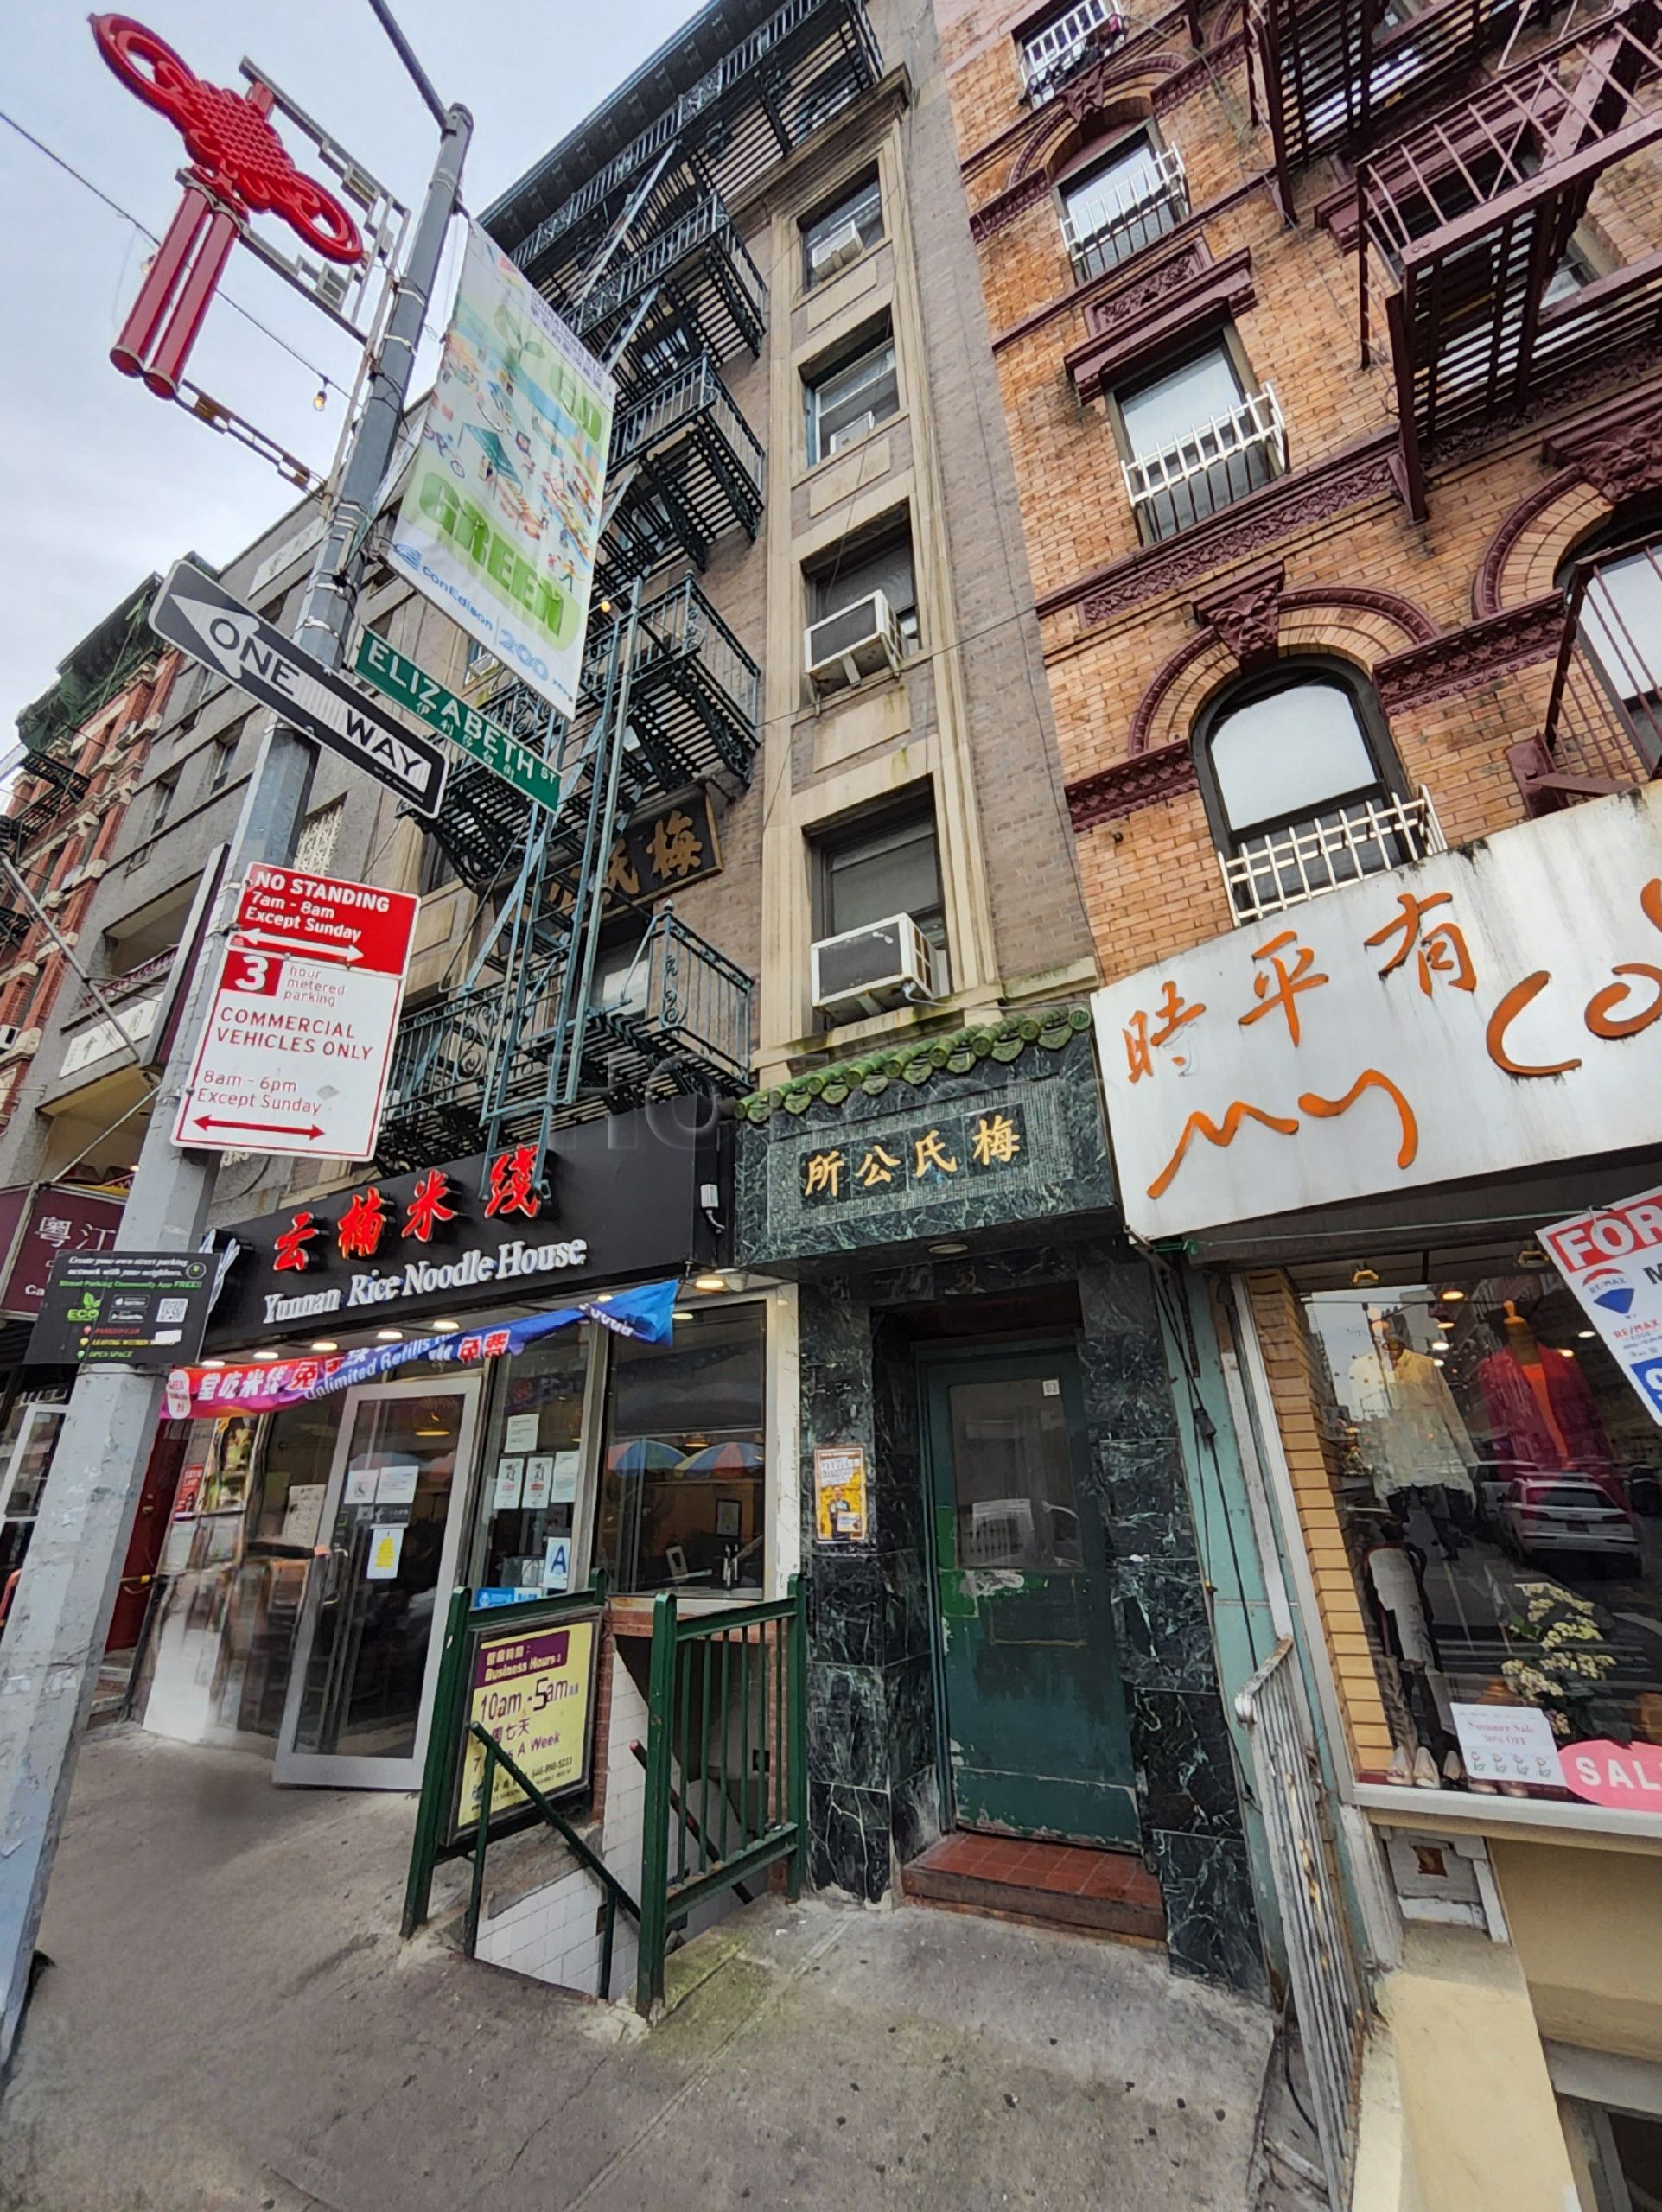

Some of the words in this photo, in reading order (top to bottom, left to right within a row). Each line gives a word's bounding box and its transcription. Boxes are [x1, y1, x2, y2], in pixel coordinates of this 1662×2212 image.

[419, 471, 564, 638] GREEN
[422, 563, 494, 632] conEdison
[498, 627, 551, 683] 200
[209, 616, 301, 696] ONE
[345, 709, 422, 777] WAY
[367, 639, 535, 779] ELIZABETH
[539, 766, 557, 785] ST
[252, 891, 285, 910] 7am
[301, 900, 335, 919] 8am
[255, 872, 286, 891] NO
[290, 878, 391, 912] STANDING
[245, 906, 301, 930] Except
[305, 919, 362, 943] Sunday
[235, 956, 269, 991] 3
[287, 978, 346, 995] metered
[290, 965, 322, 980] hour
[283, 990, 336, 1008] parking
[220, 1007, 355, 1039] COMMERCIAL
[217, 1027, 315, 1053] VEHICLES
[322, 1040, 373, 1061] ONLY
[203, 1069, 242, 1087] 8am
[259, 1076, 297, 1093] 6pm
[197, 1088, 257, 1109] Except
[262, 1094, 322, 1116] Sunday
[805, 1114, 1021, 1197] 梅氏公所
[262, 1287, 342, 1324] Yunnan
[347, 1269, 403, 1307] Rice
[402, 1249, 496, 1296] Noodle
[495, 1238, 589, 1280] House
[1589, 1278, 1627, 1294] RE/MAX
[67, 1308, 100, 1321] ECO
[1613, 1319, 1659, 1338] RE/MAX
[304, 1358, 377, 1401] Unlimited
[380, 1337, 431, 1370] Refills
[550, 1544, 567, 1573] A
[484, 1661, 528, 1682] Business
[529, 1655, 556, 1670] Hours
[481, 1691, 522, 1723] 10am
[1468, 1720, 1510, 1732] Summer
[1512, 1723, 1534, 1733] Sale
[517, 1742, 526, 1758] A
[531, 1730, 561, 1752] Week
